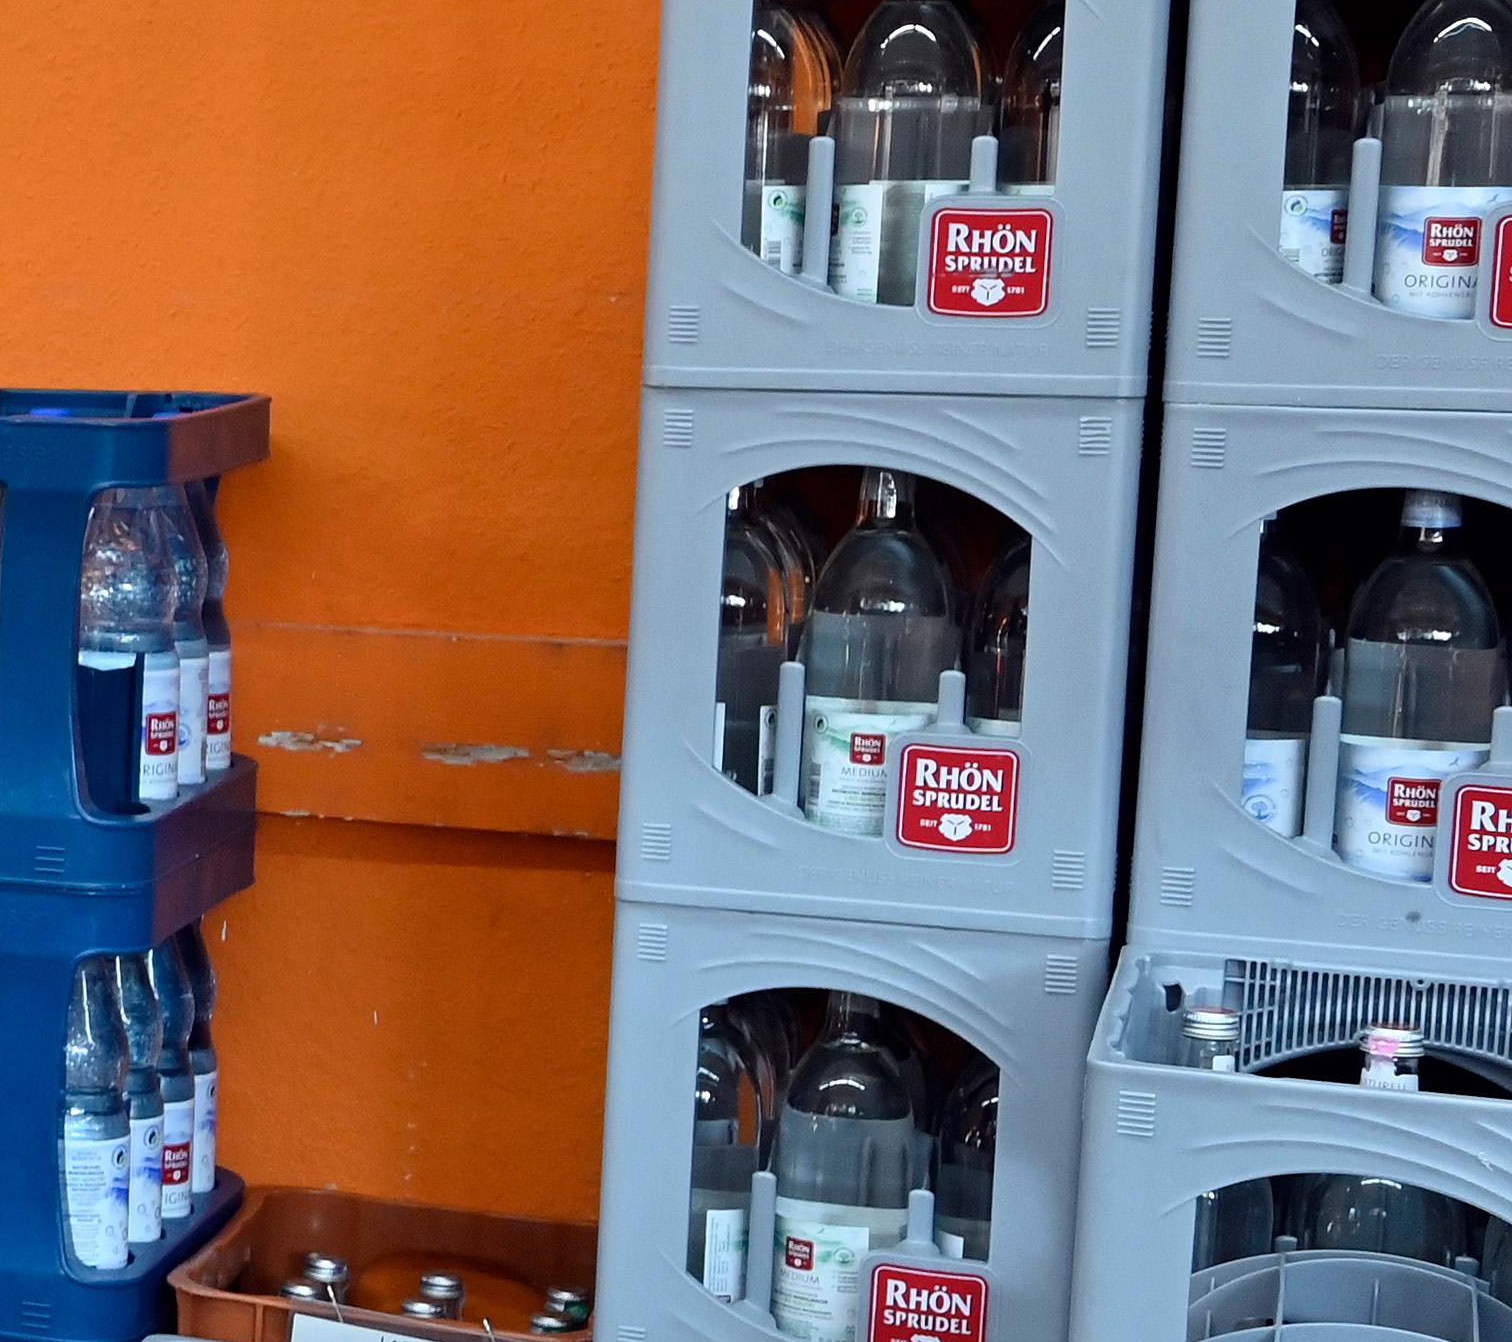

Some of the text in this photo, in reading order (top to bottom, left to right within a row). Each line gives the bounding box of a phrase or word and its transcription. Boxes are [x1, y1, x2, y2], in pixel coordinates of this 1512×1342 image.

[947, 222, 1038, 253] RHÖN
[1430, 224, 1474, 239] RHÖN
[945, 255, 1036, 273] SPRUDEL
[914, 758, 1004, 793] RHÖN
[912, 790, 1003, 812] SPRUDEL
[1394, 783, 1436, 800] RHÖN
[1467, 833, 1512, 854] SPR
[885, 1278, 973, 1317] RHÖN
[883, 1309, 972, 1335] SPRUDEL
